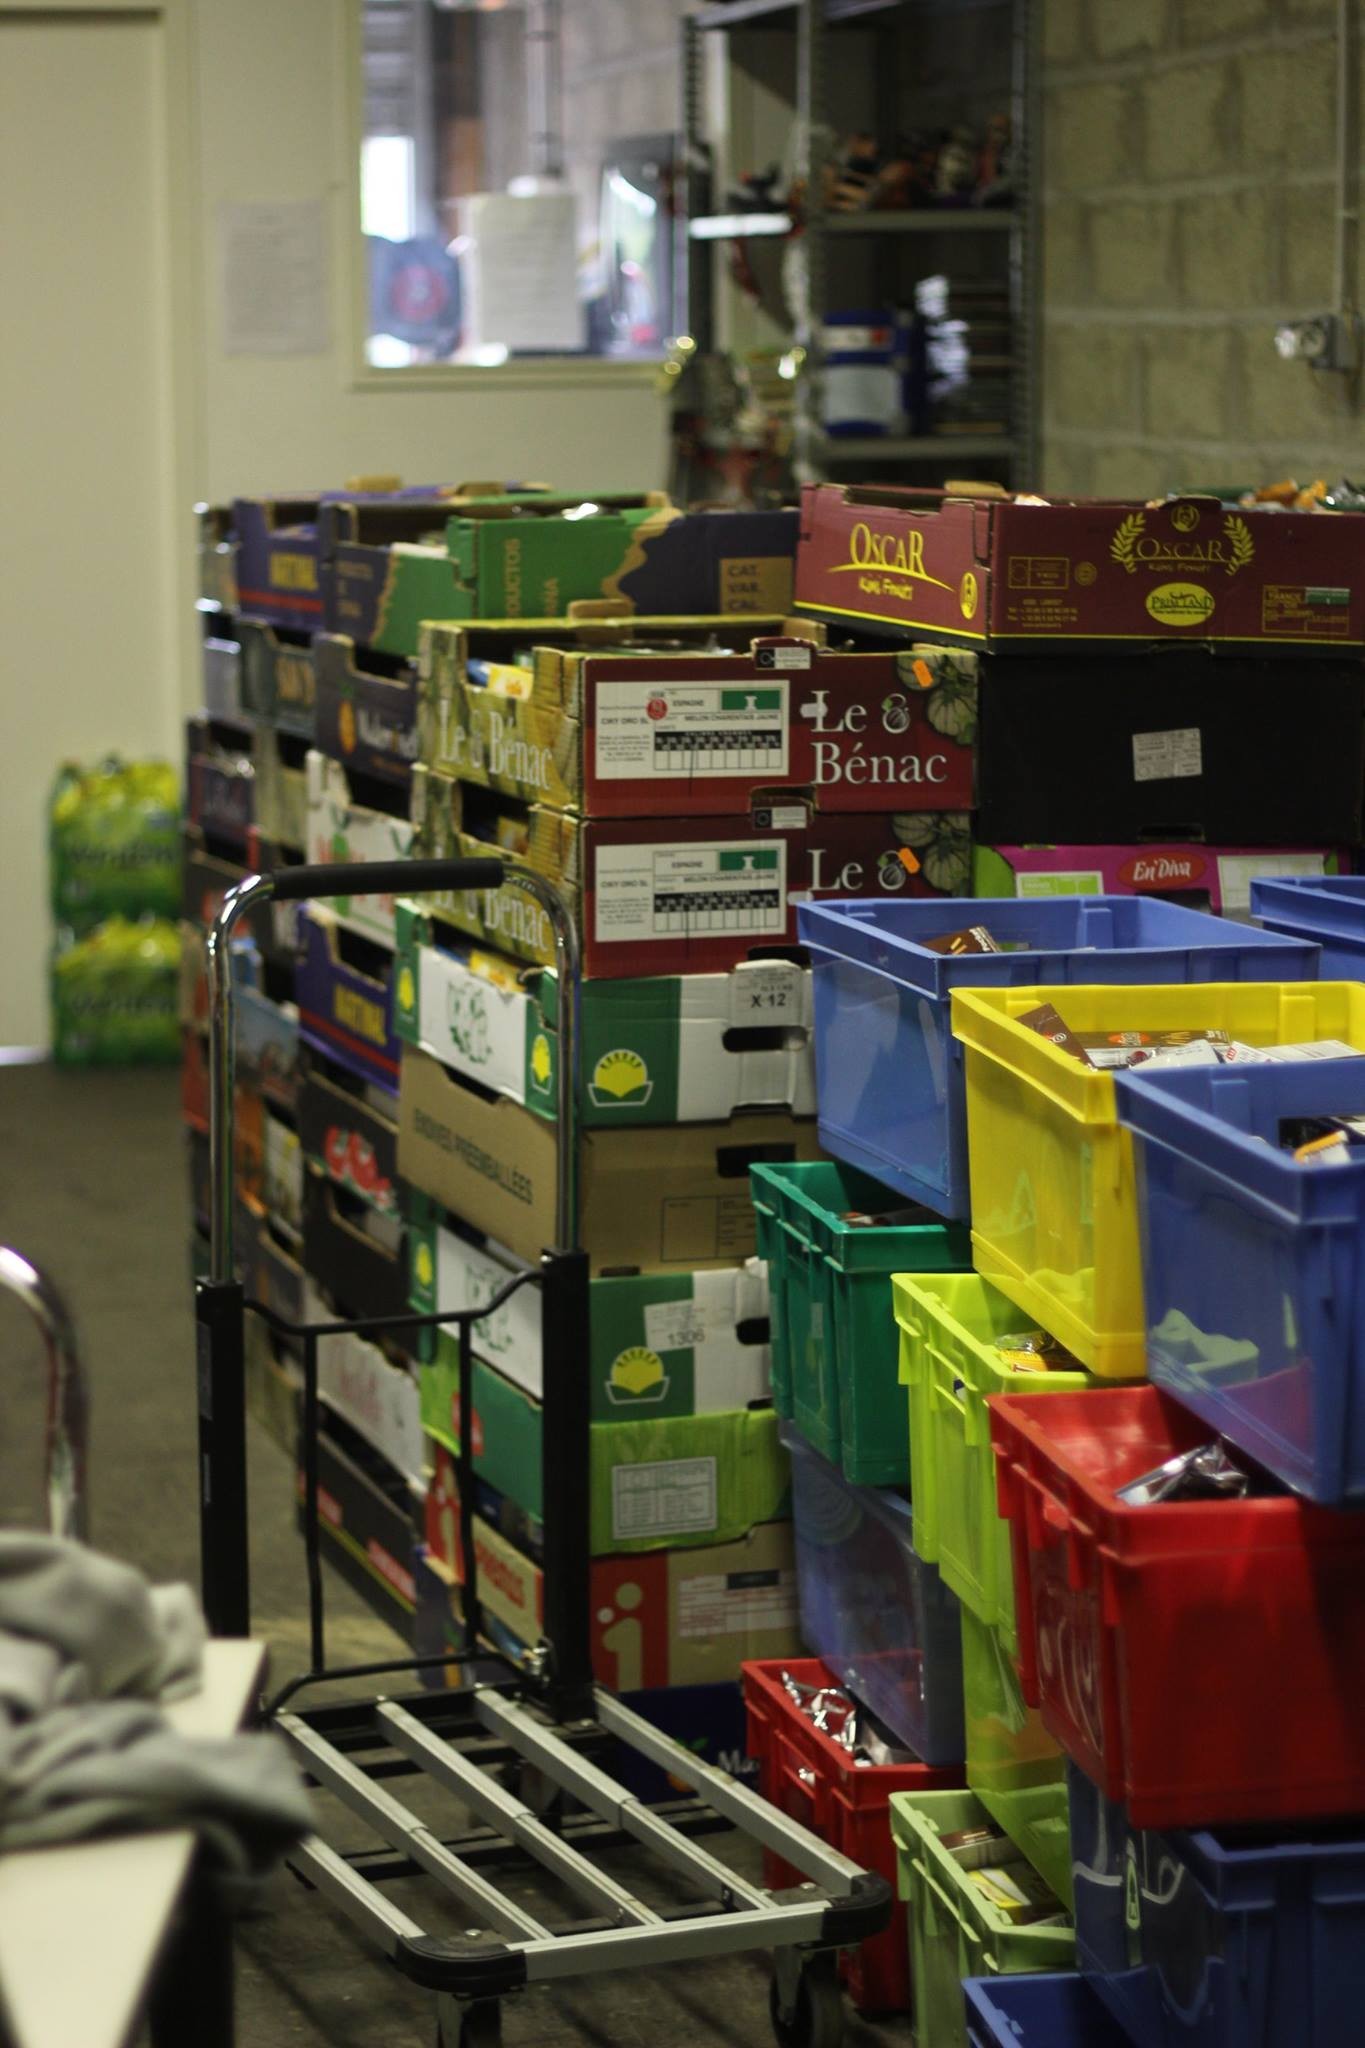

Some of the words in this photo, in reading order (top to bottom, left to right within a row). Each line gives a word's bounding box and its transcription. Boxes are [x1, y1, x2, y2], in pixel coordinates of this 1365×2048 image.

[851, 523, 926, 576] OSCAR
[1136, 538, 1225, 562] OSCAR
[810, 690, 867, 733] Le
[440, 699, 465, 766] Le
[489, 710, 553, 790] Bénac
[810, 742, 948, 784] Bénac
[807, 849, 864, 890] Le
[768, 992, 786, 1007] 12
